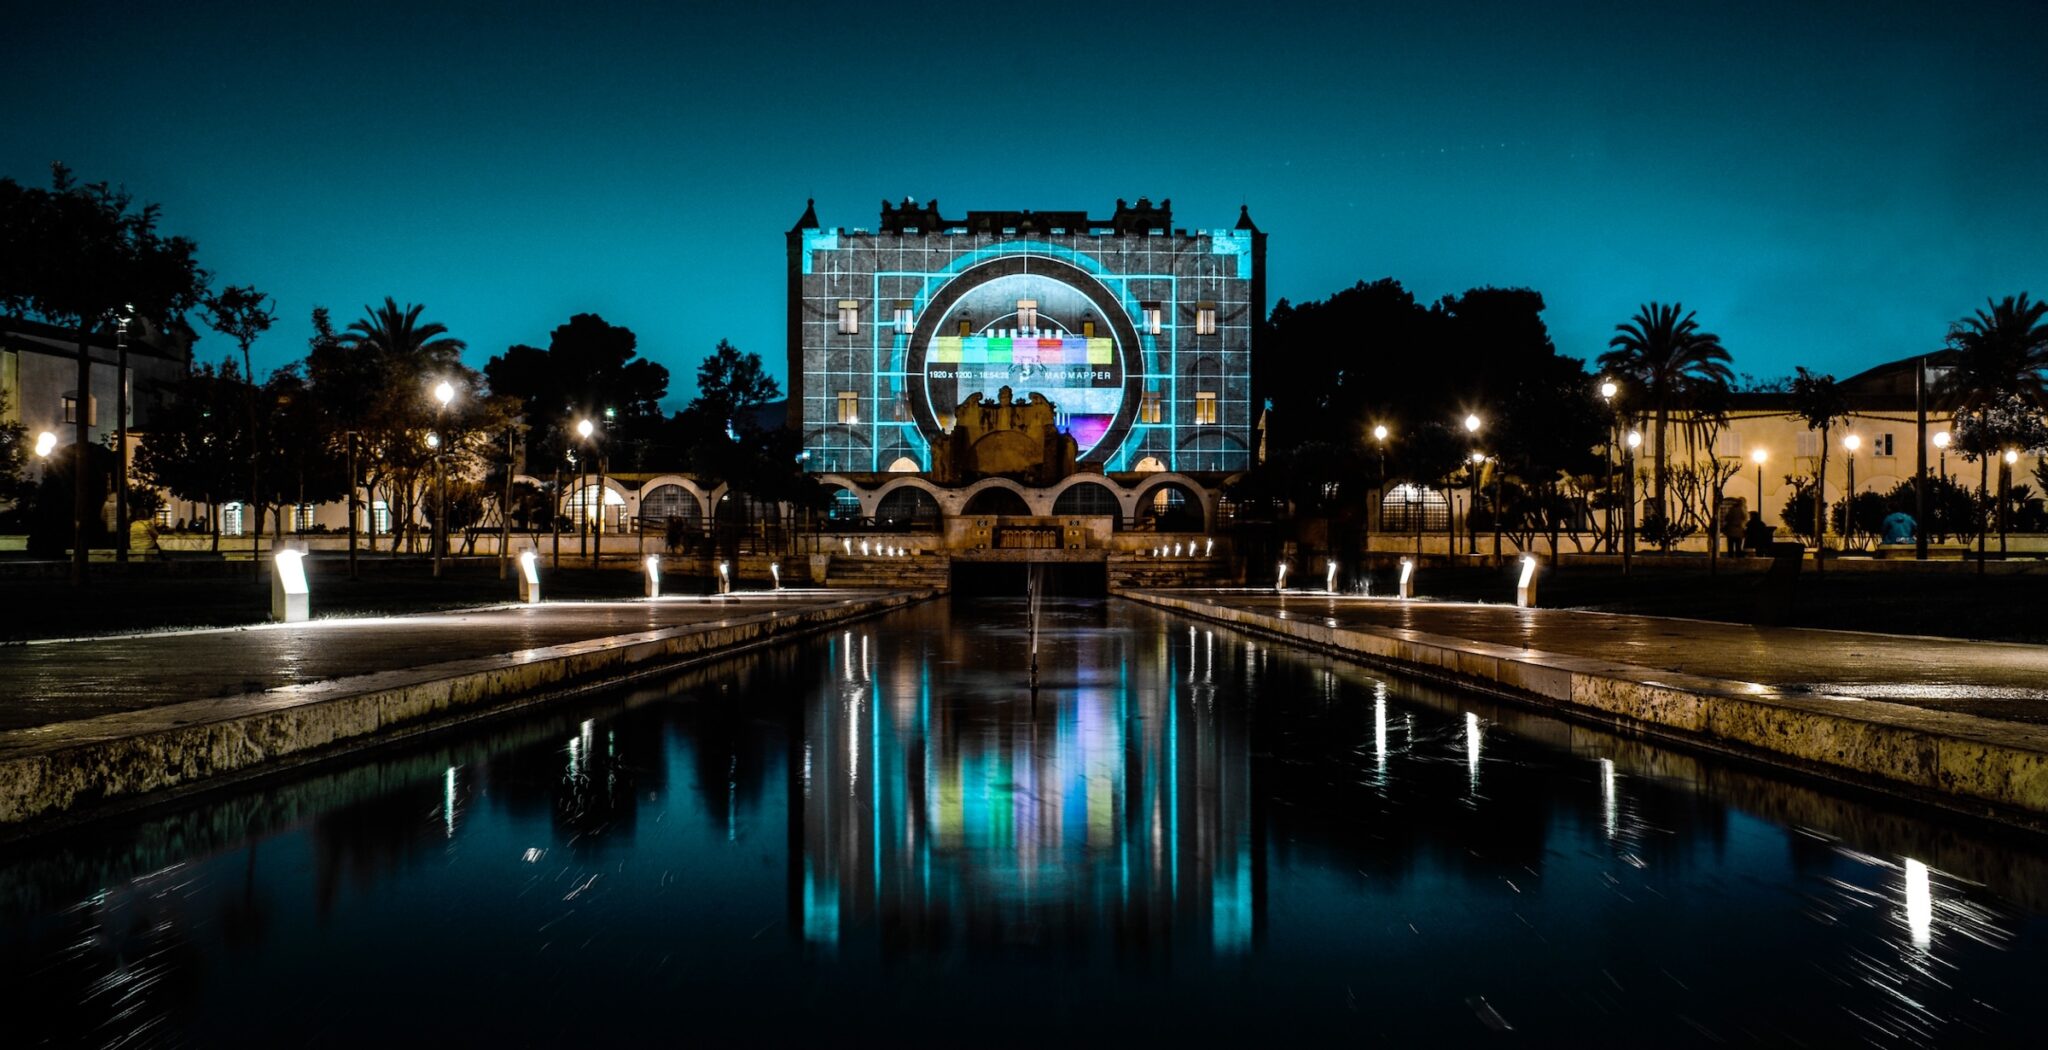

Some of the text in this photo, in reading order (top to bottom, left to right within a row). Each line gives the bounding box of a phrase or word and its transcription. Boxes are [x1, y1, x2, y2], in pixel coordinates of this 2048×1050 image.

[929, 371, 947, 379] 1920
[955, 371, 972, 379] 1200
[1045, 371, 1111, 379] MADMAPPER
